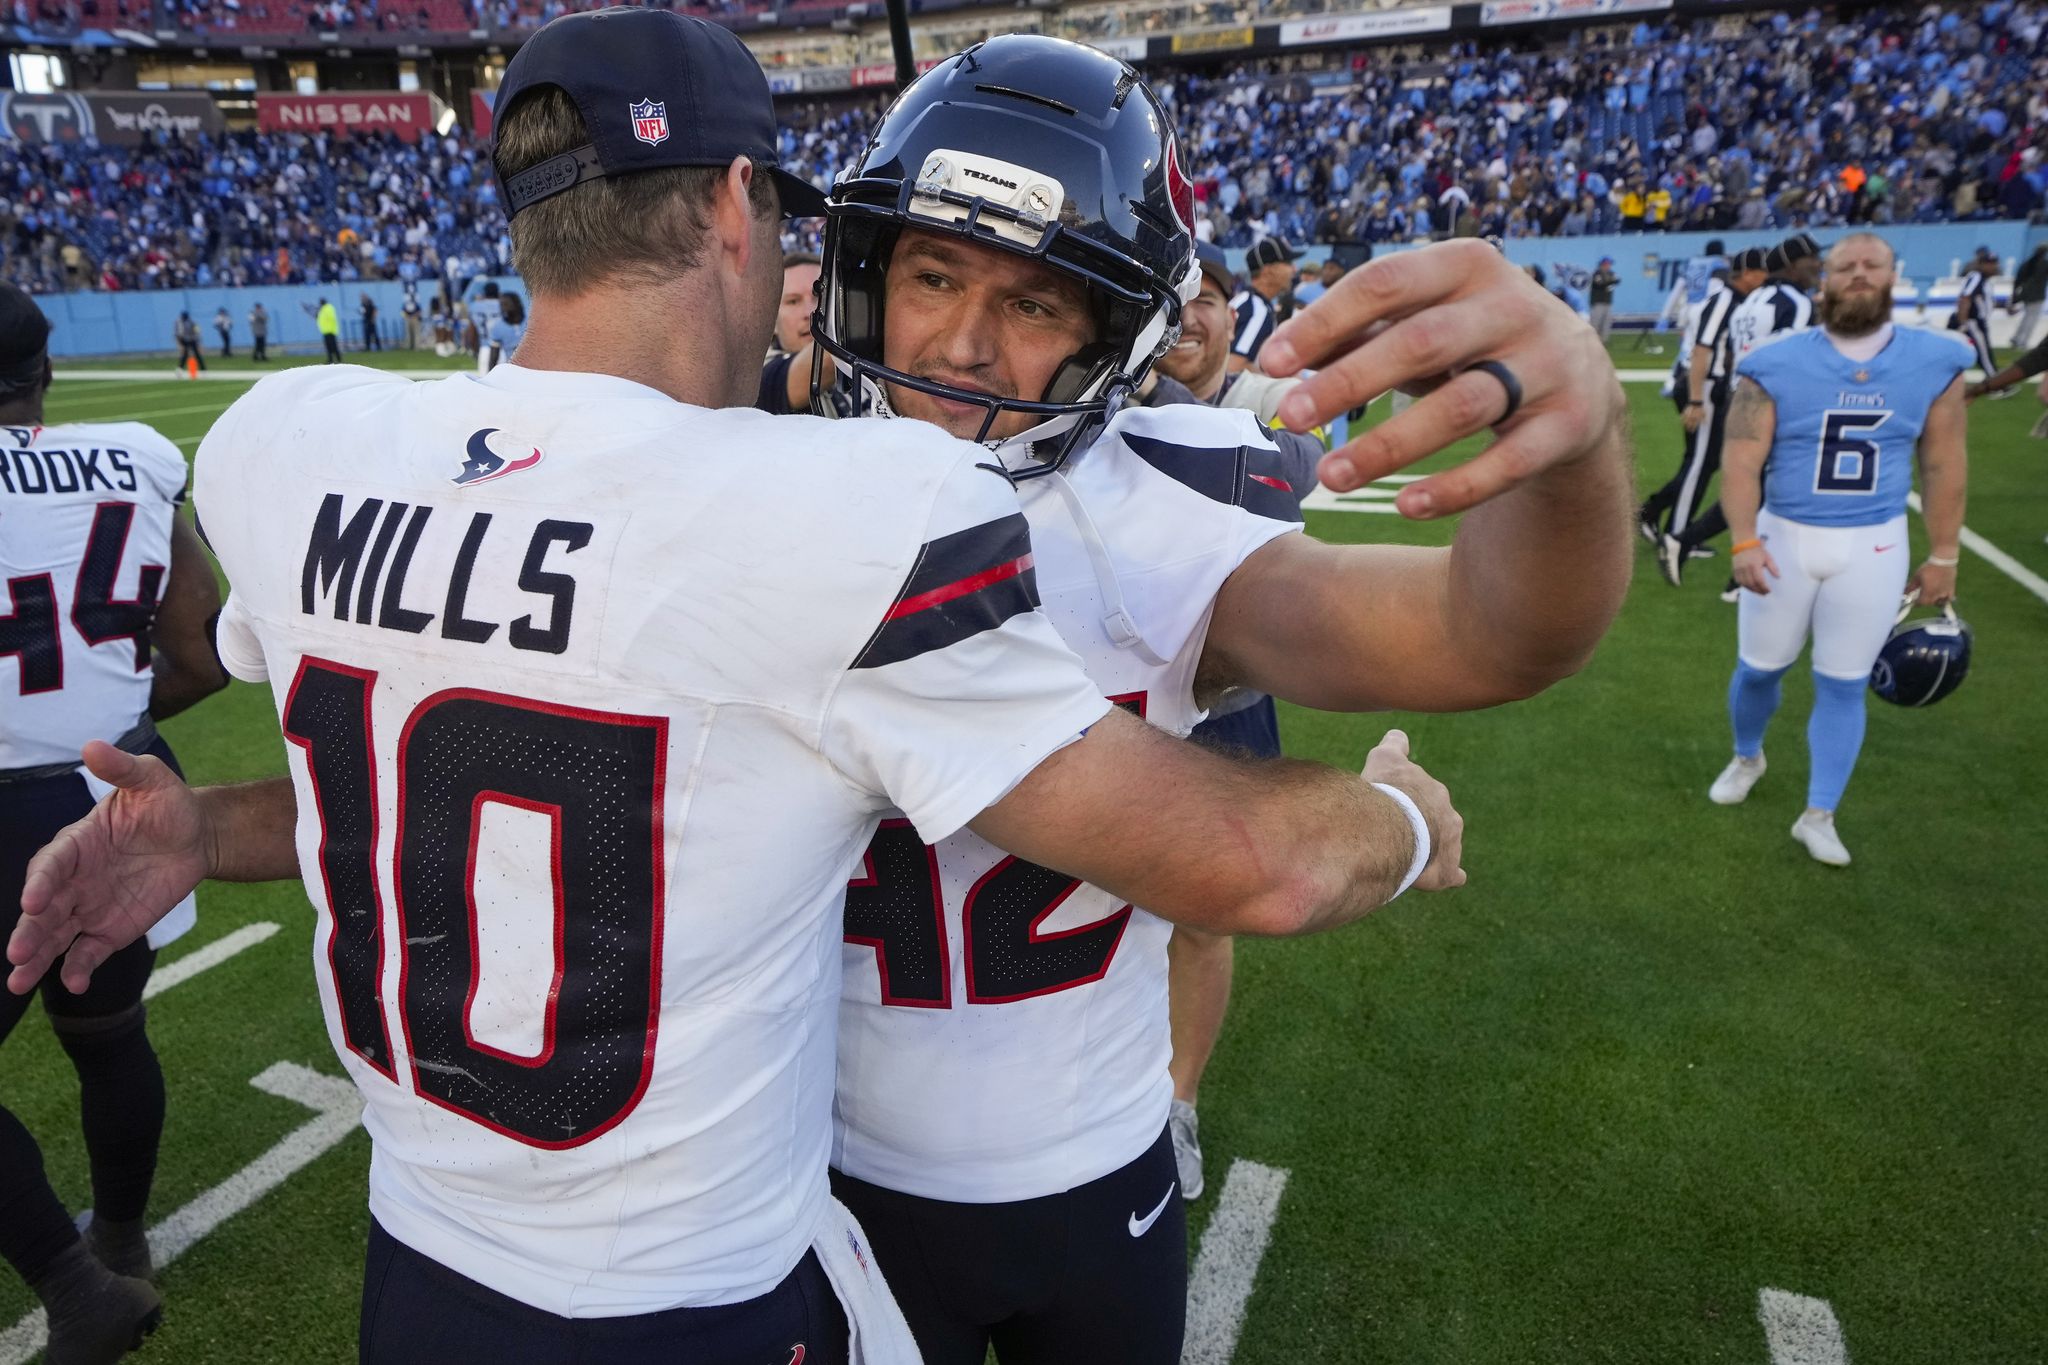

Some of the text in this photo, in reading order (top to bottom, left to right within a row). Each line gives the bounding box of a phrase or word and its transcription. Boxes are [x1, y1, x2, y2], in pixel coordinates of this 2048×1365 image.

[279, 103, 412, 124] NISSAN
[637, 118, 666, 140] NFL
[963, 168, 1018, 190] TEXANS
[1812, 408, 1894, 495] 6
[301, 493, 594, 655] MILLS
[282, 654, 670, 1151] 10
